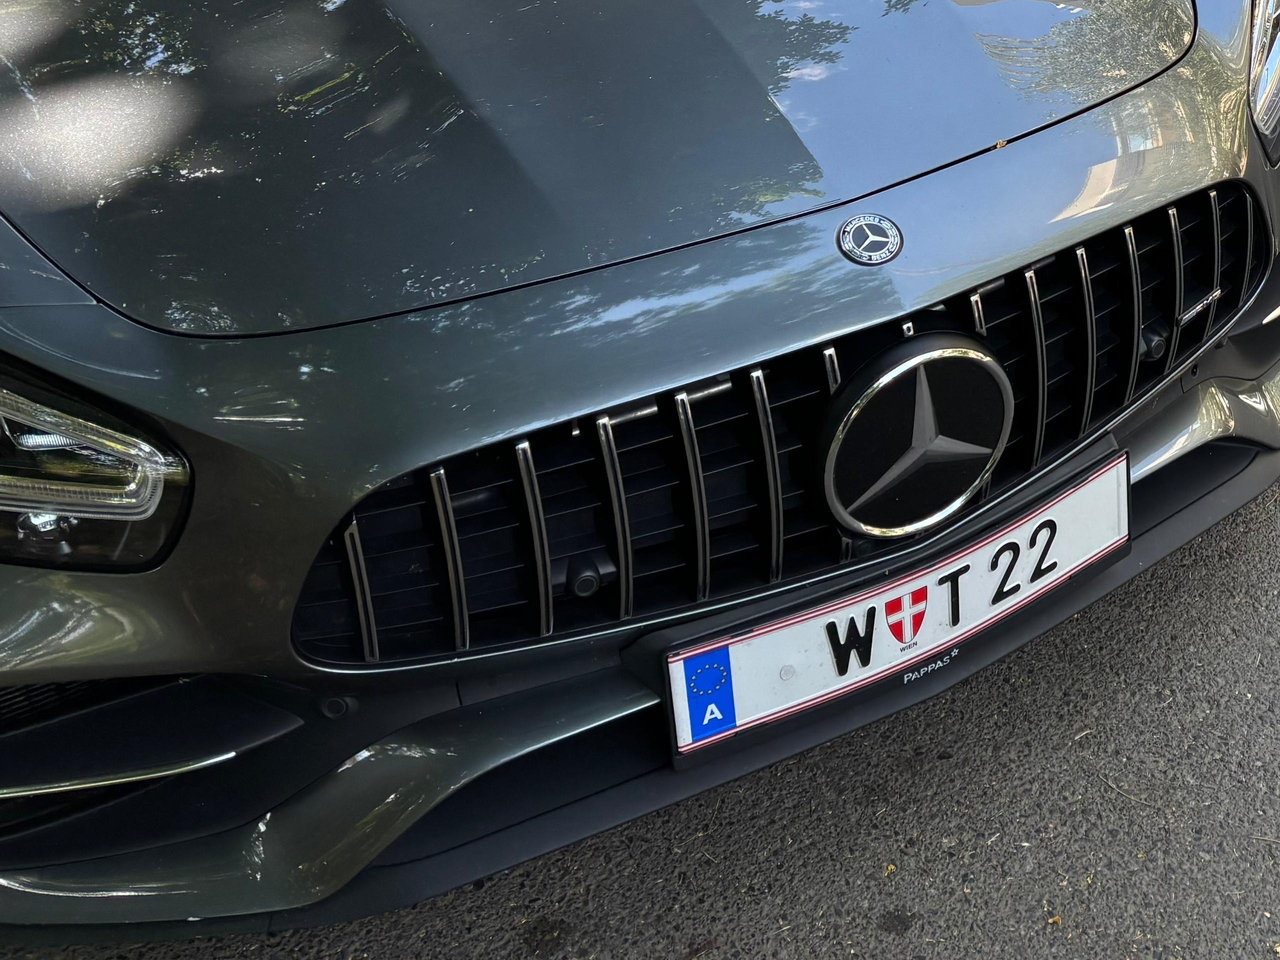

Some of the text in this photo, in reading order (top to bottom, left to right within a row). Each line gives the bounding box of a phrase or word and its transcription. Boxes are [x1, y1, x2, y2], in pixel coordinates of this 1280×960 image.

[871, 249, 891, 261] BENZ
[825, 518, 1058, 677] W T 22
[899, 641, 918, 653] WIEN
[903, 655, 951, 685] PAPPAS
[702, 703, 724, 726] A
